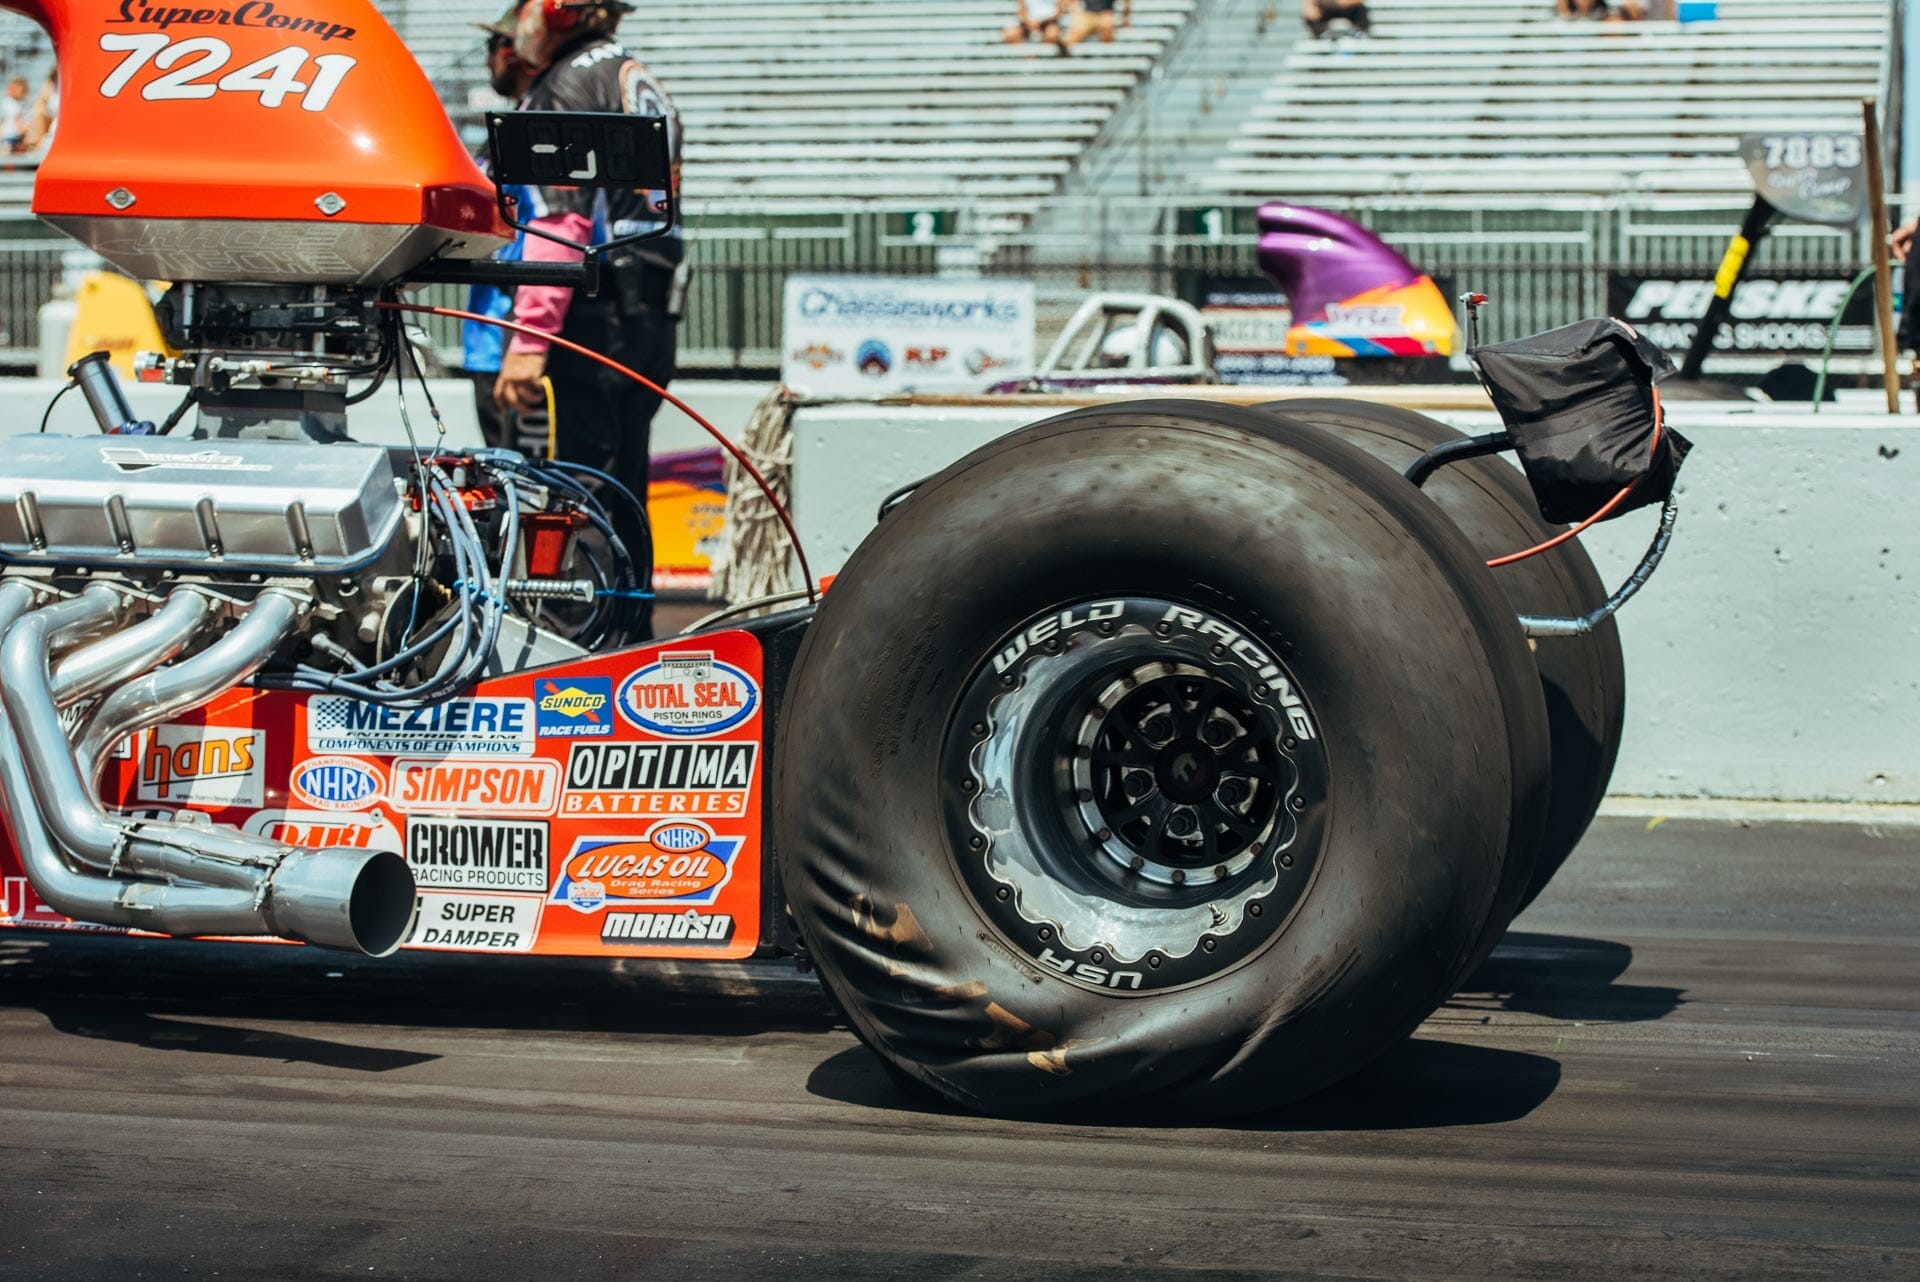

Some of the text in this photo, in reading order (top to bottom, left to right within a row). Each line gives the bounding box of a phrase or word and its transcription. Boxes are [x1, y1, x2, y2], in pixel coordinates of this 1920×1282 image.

[99, 33, 358, 112] 7241
[1762, 134, 1862, 169] 7883
[911, 212, 936, 243] 2
[1202, 208, 1222, 243] 1
[992, 600, 1317, 741] WELD RACING
[544, 696, 602, 709] SUNOCO
[632, 682, 742, 709] TOTAL SEAL
[348, 698, 527, 733] MEZIERE
[653, 710, 723, 720] PISTON RINGS
[539, 724, 611, 736] RACE FUELS
[318, 738, 521, 753] COMPONENTS OF CHAMPIONS
[143, 727, 256, 799] hans
[306, 759, 369, 771] CHAMPIONSHIP
[571, 747, 748, 787] OPTIMA
[305, 767, 371, 800] NHRA
[403, 766, 546, 804] SIMPSON
[306, 795, 330, 807] DRAG
[565, 793, 742, 812] BATTERIES
[411, 823, 544, 870] CROWER
[658, 828, 704, 849] NHRA
[411, 868, 544, 886] RACING PRODUCTS
[576, 854, 712, 879] LUCAS OIL
[610, 880, 702, 889] Drag Racing
[628, 888, 676, 896] Series
[441, 902, 516, 923] SUPER
[422, 928, 520, 948] DAMPER
[601, 912, 732, 940] MOROSO
[1037, 946, 1145, 990] USA
